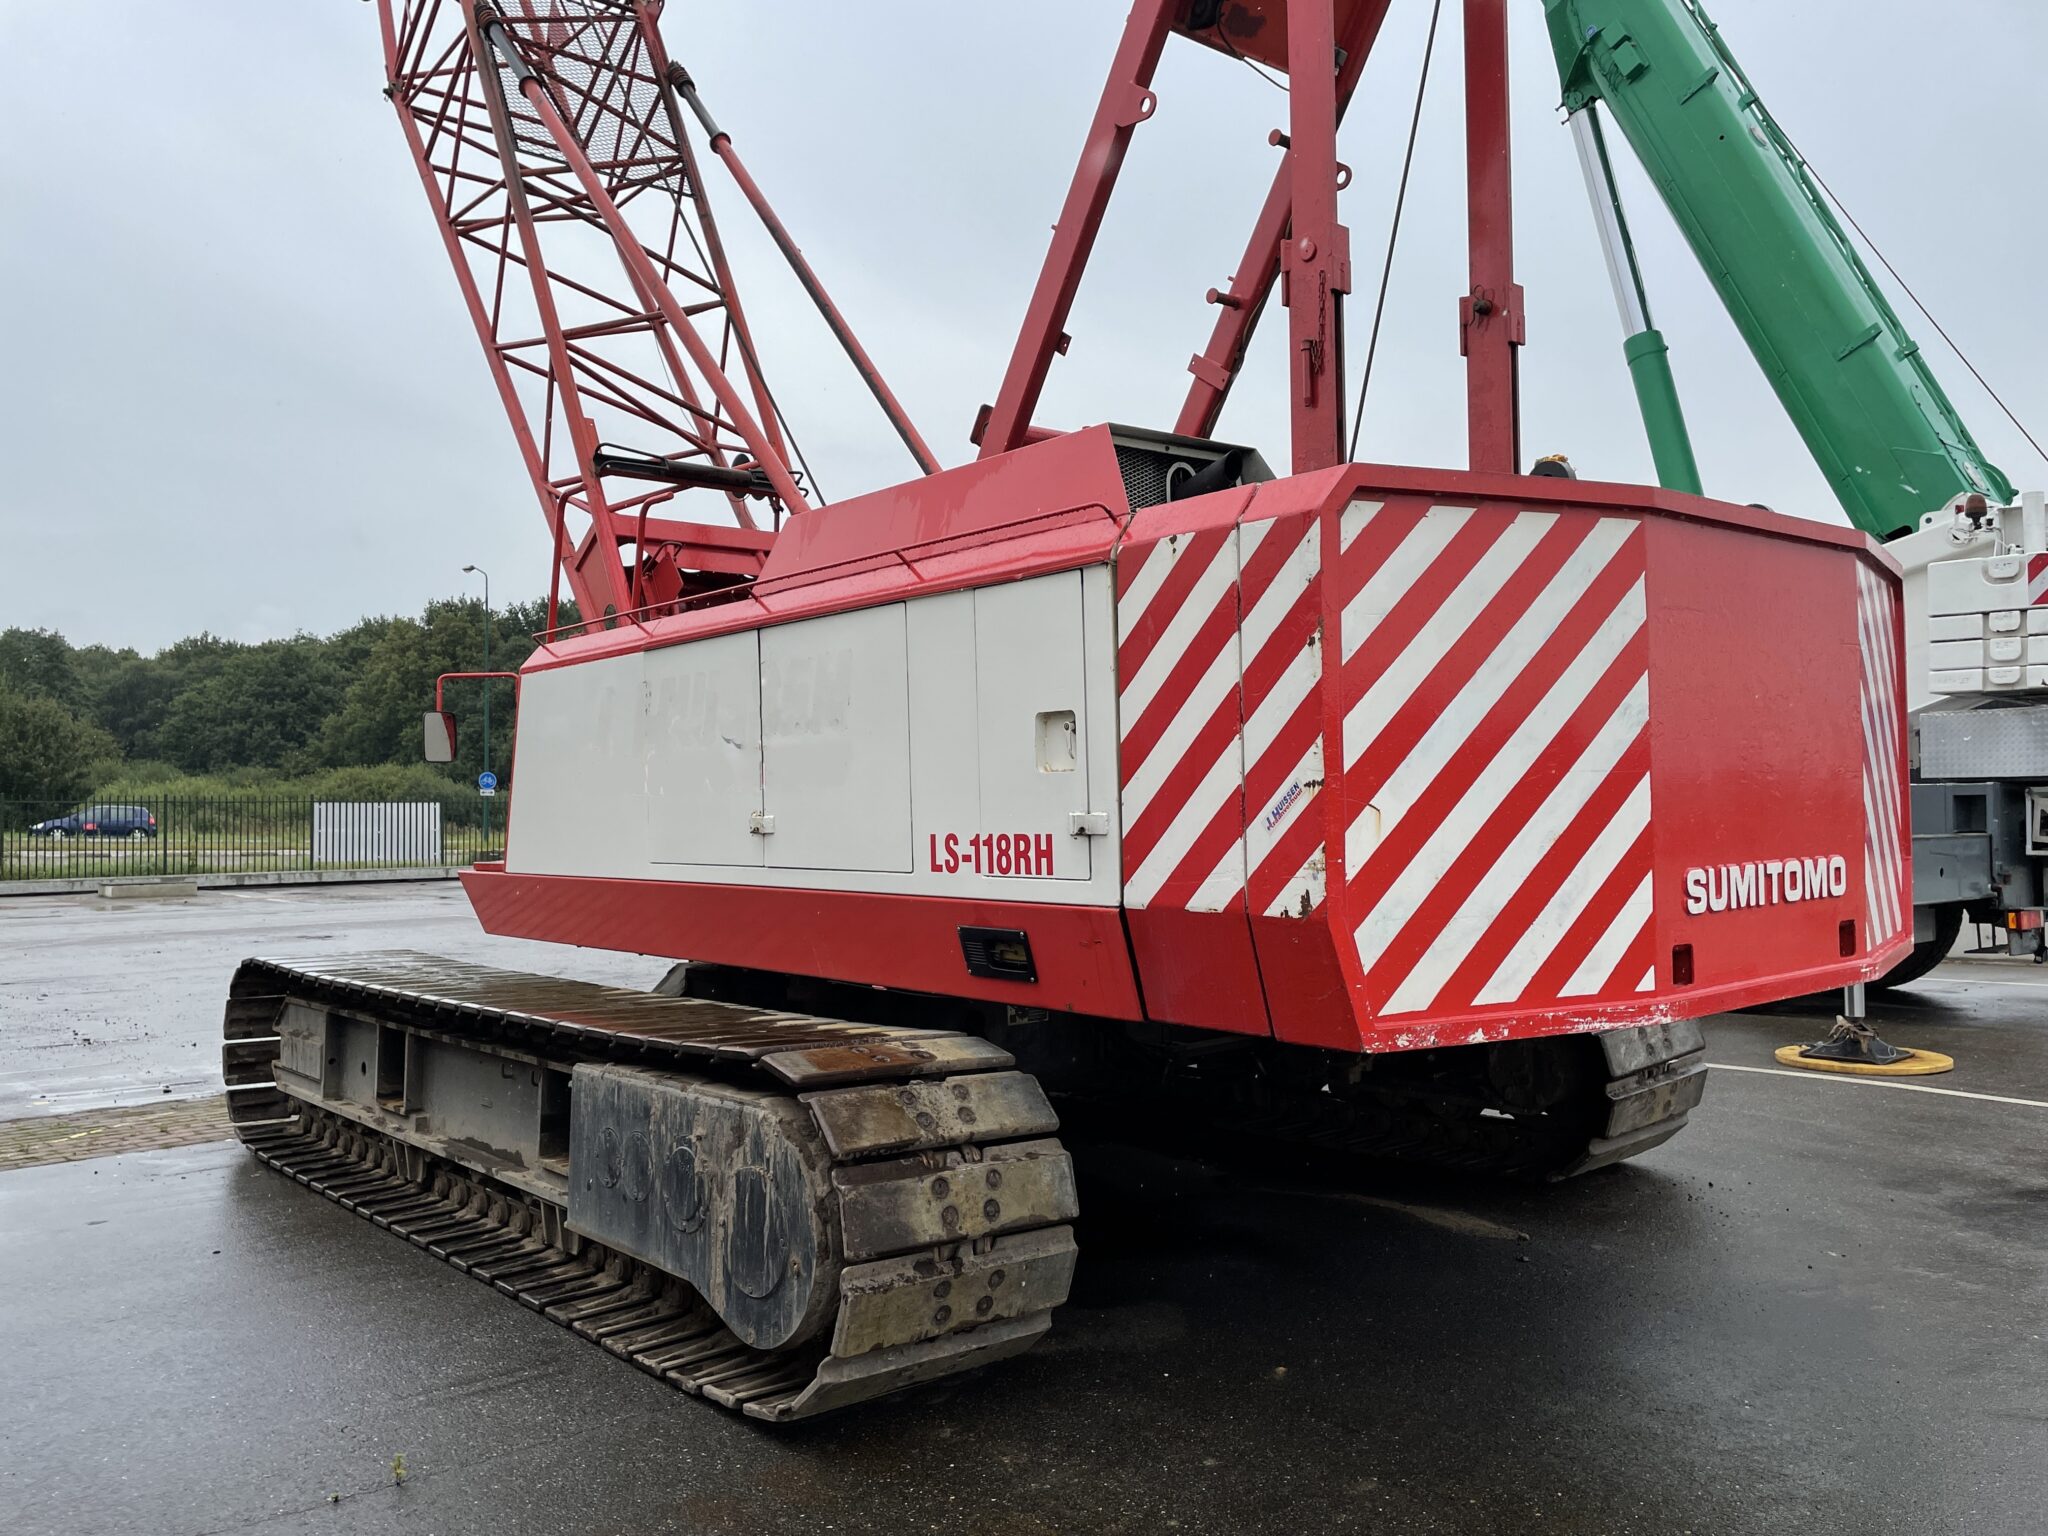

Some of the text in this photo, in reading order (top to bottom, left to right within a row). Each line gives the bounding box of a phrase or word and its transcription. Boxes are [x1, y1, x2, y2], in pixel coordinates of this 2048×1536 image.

[1271, 781, 1300, 820] HUISSEN
[930, 833, 1054, 876] LS-118RH
[1685, 854, 1847, 915] SUMITOMO
